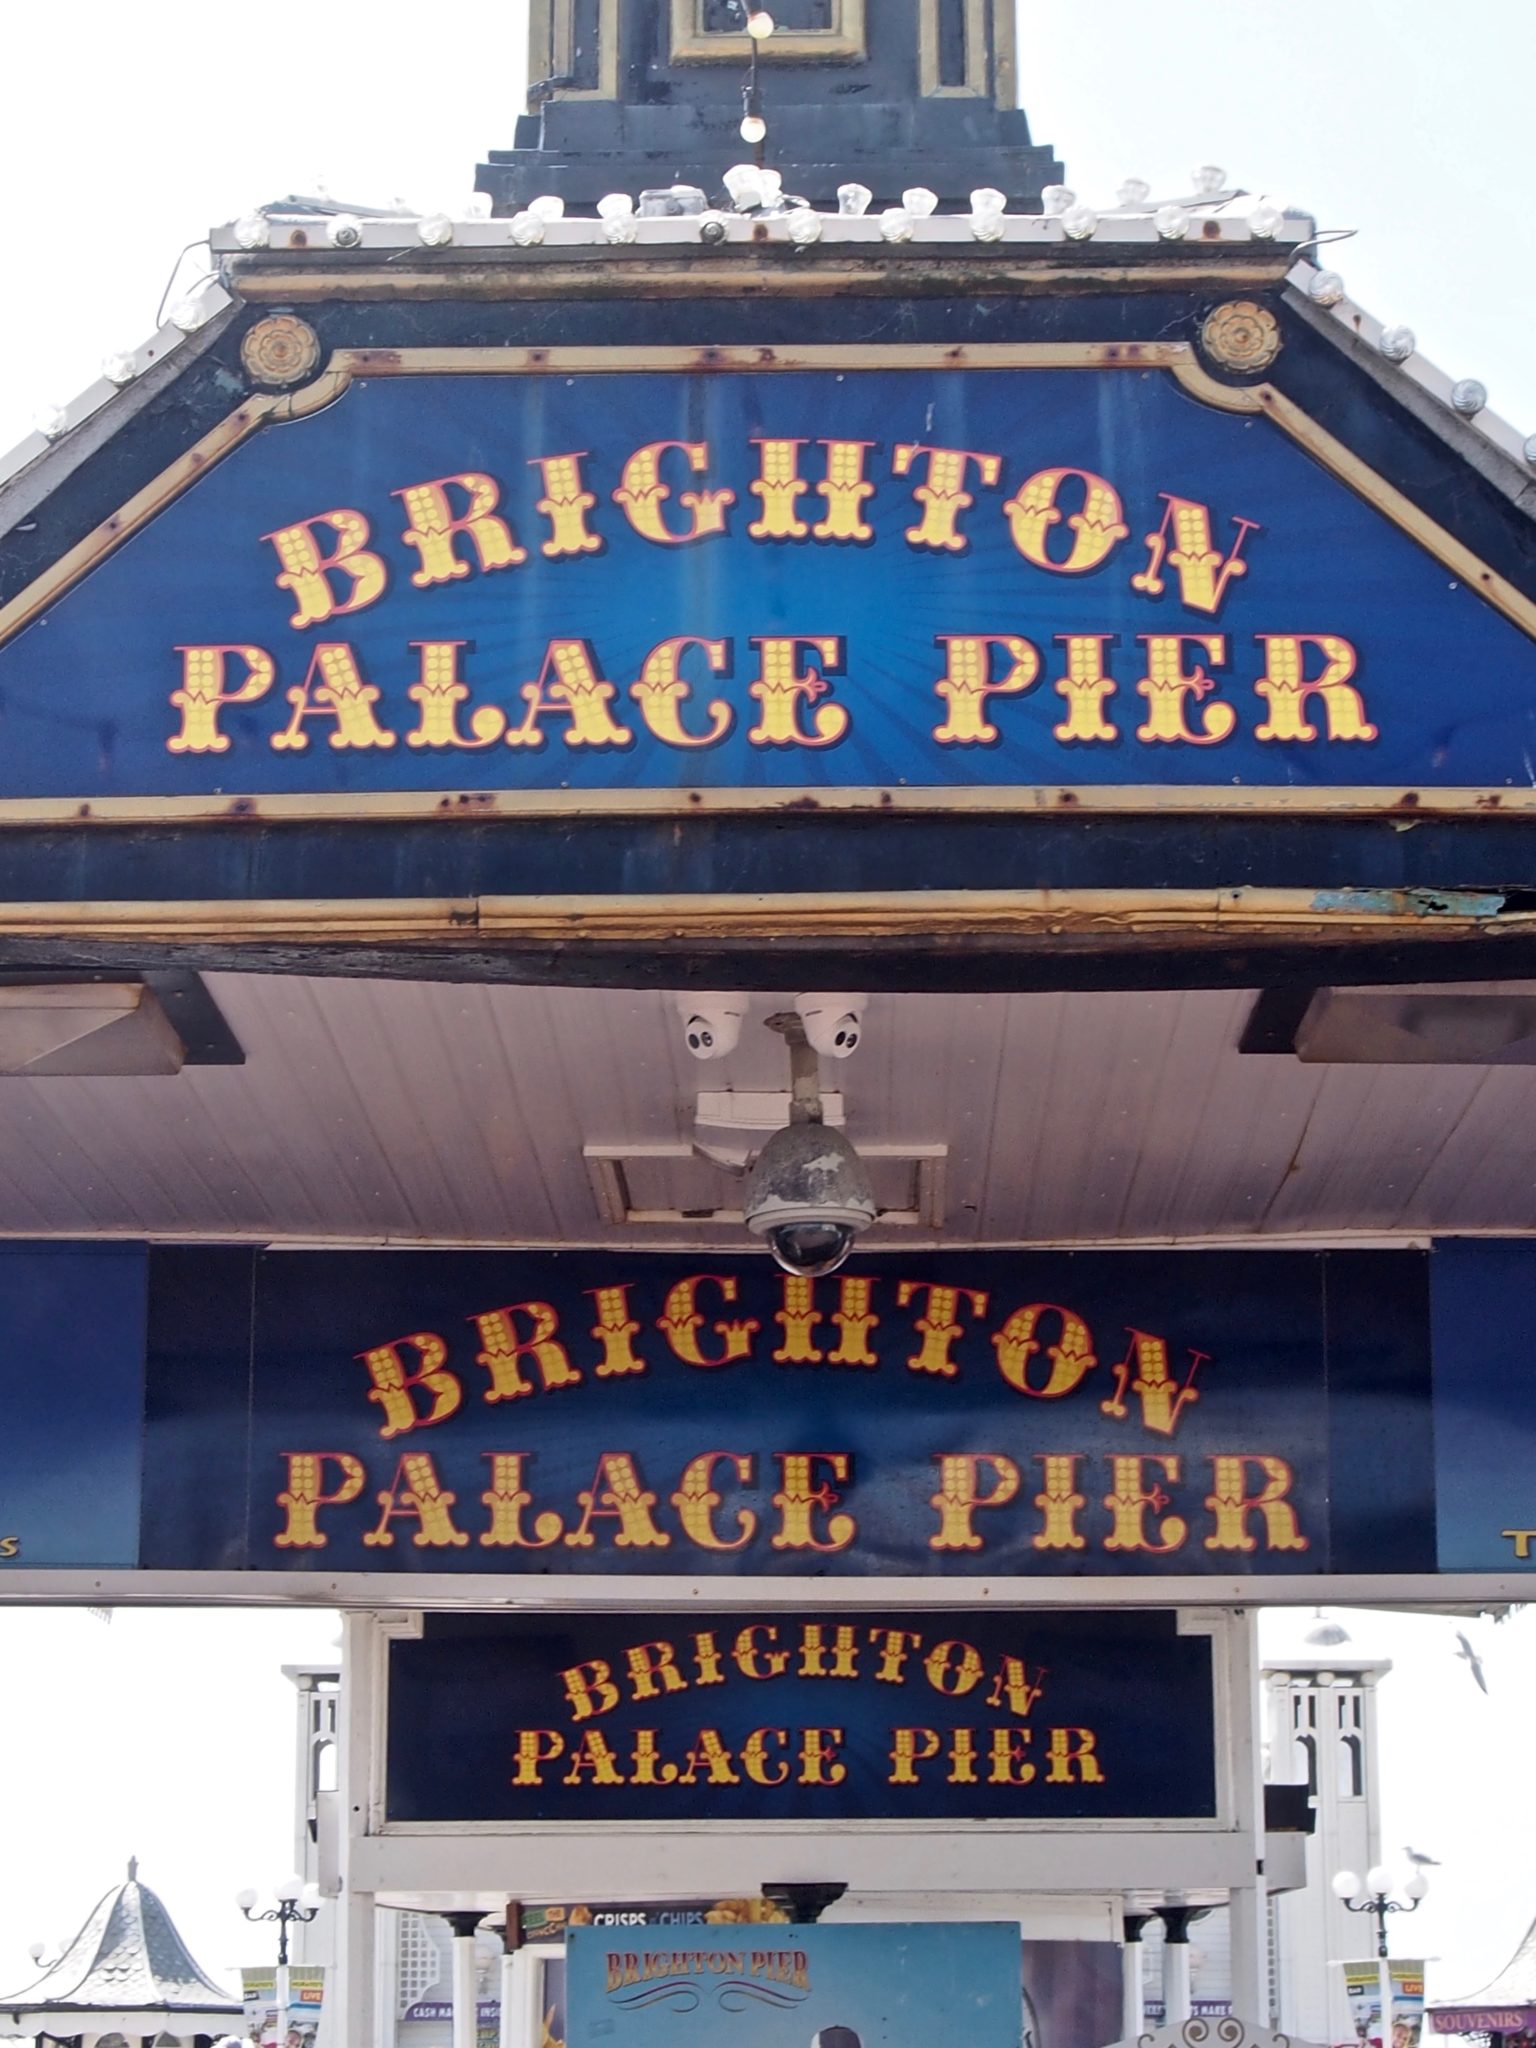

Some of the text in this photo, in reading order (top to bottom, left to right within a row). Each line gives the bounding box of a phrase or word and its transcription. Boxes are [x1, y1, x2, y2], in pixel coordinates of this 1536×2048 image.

[259, 438, 1260, 628] BRIGHTON
[166, 634, 1378, 754] PALACE PIER
[353, 1273, 1212, 1439] BRIGHTON
[273, 1451, 1308, 1552] PALACE PIER
[554, 1623, 1048, 1721] BRIGHTON
[511, 1728, 1104, 1785] PALACE PIER
[413, 2007, 436, 2018] CASH
[605, 1950, 812, 1994] BRIGHTON PIER
[1435, 2012, 1524, 2030] SOUVENIRS
